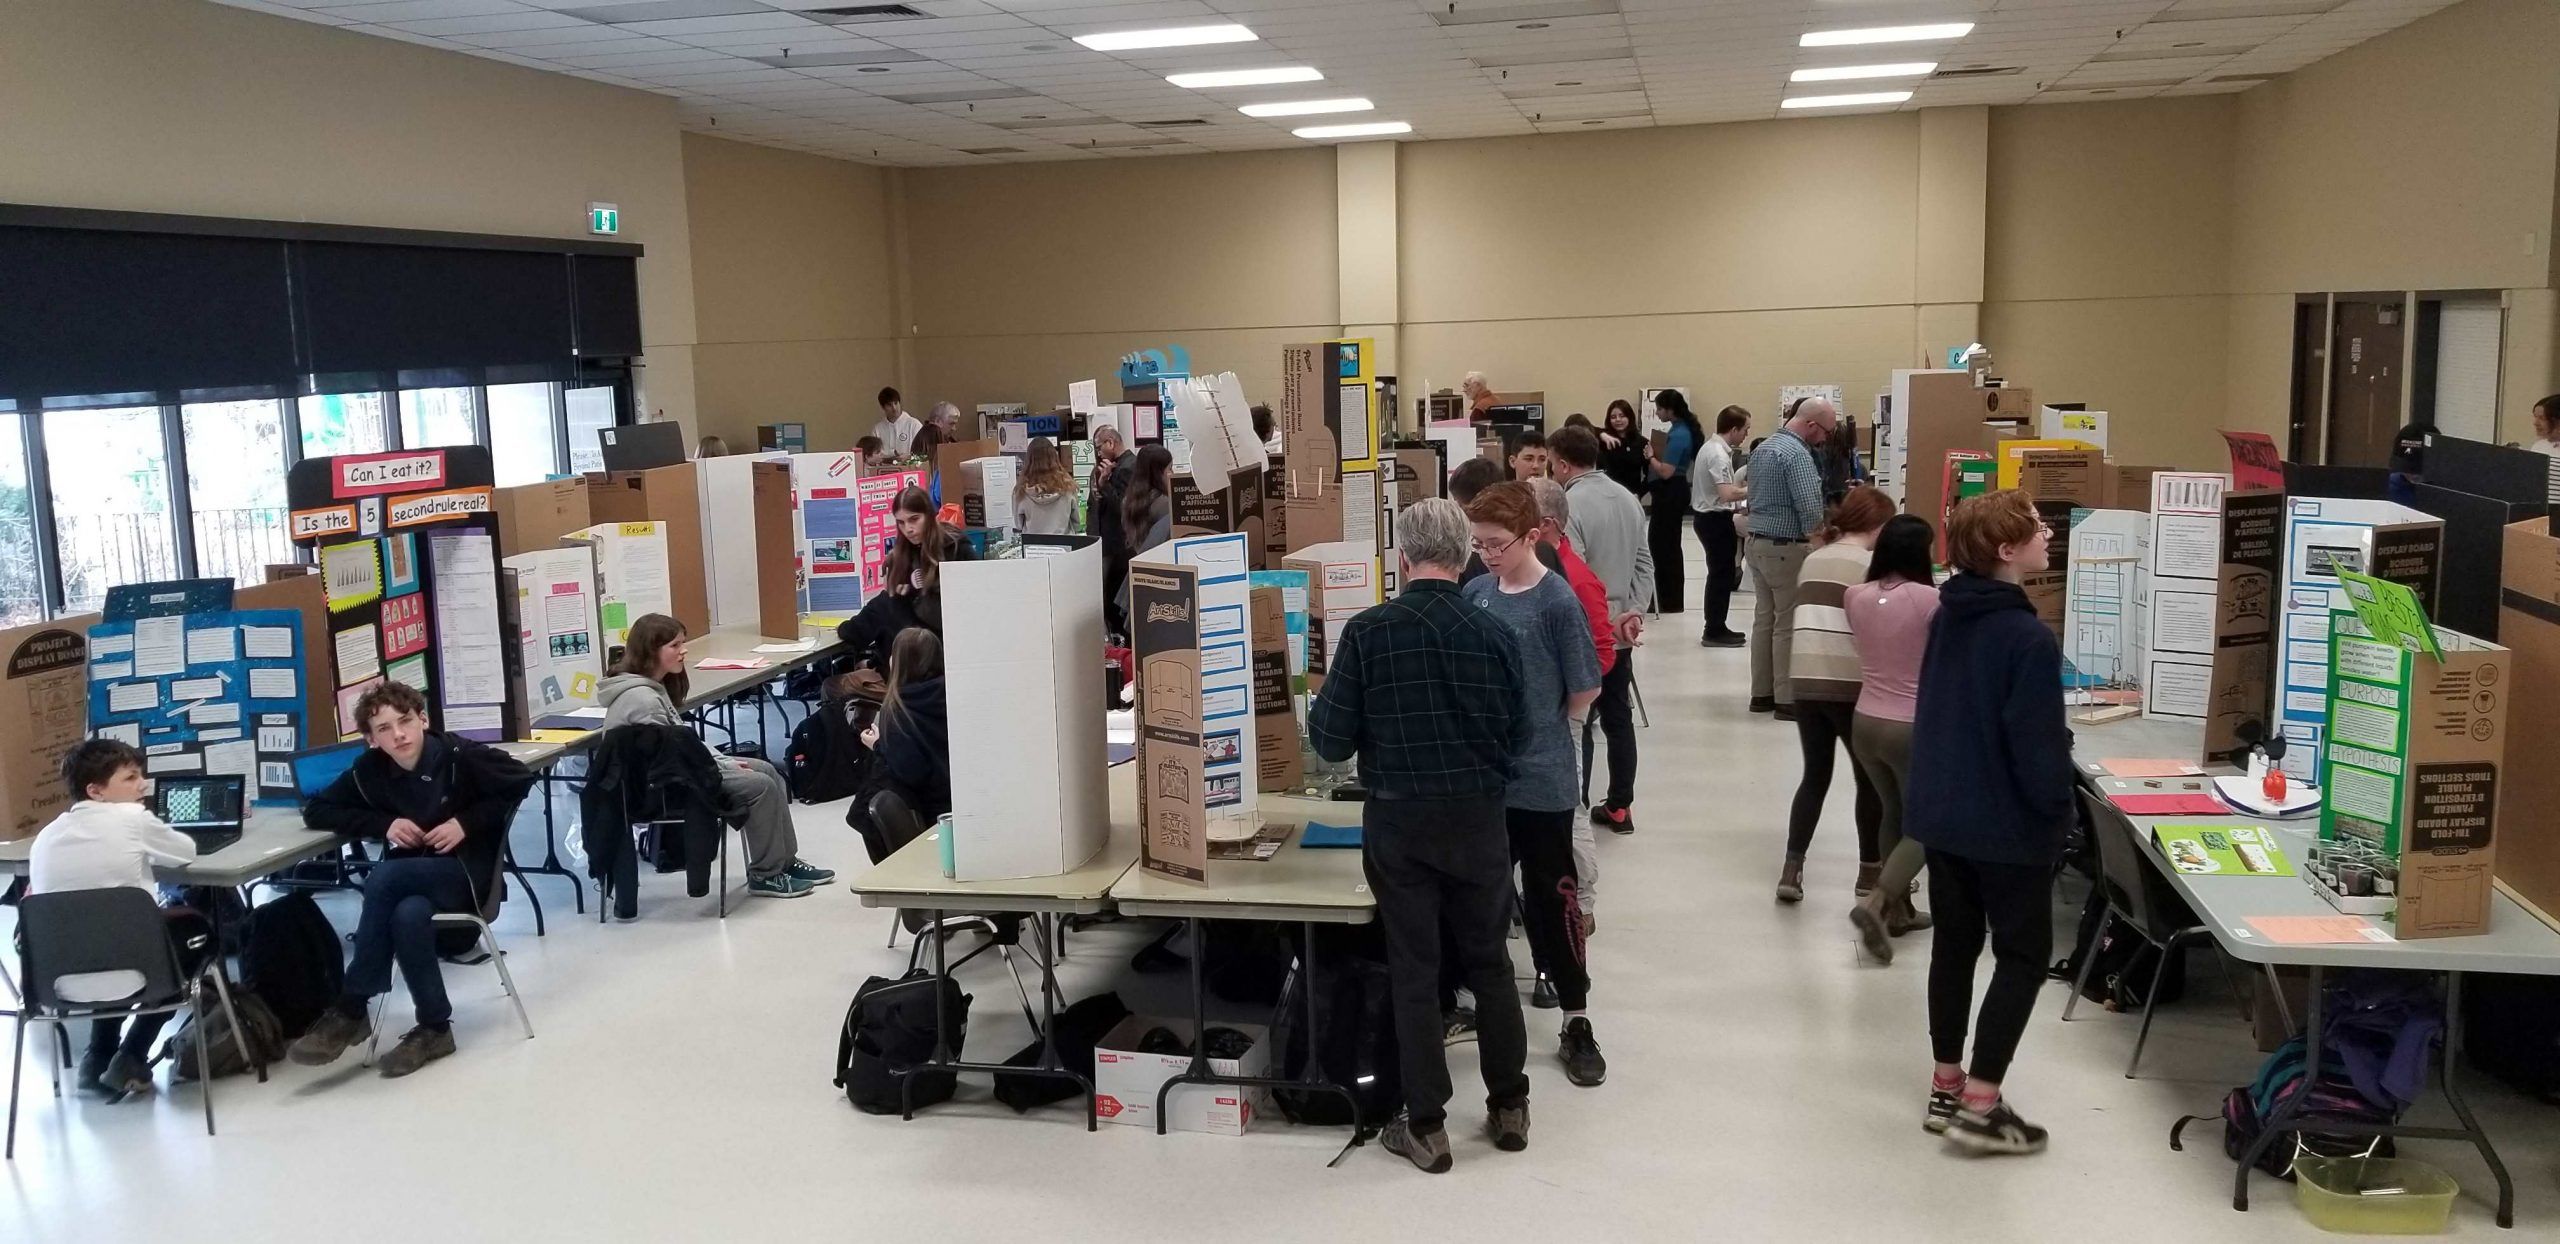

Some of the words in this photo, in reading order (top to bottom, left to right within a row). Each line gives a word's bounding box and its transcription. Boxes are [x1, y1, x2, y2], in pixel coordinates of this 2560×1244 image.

[351, 468, 374, 483] Can
[379, 465, 388, 480] I
[391, 464, 412, 479] eat
[415, 460, 432, 476] it?
[366, 508, 376, 524] 5
[2228, 508, 2257, 518] DISPLAY
[2258, 506, 2279, 515] BOARD
[302, 516, 318, 532] Is
[325, 513, 349, 529] the
[2233, 550, 2242, 559] DE
[2378, 545, 2408, 555] DISPLAY
[2408, 543, 2434, 553] BOARD
[2335, 616, 2361, 634] QUE
[31, 636, 72, 653] PROJECT
[17, 651, 58, 669] DISPLAY
[2340, 681, 2395, 706] PURPOSE
[2331, 745, 2400, 774] HYPOTHESIS
[2420, 773, 2464, 783] SECTIONS
[2466, 772, 2491, 781] TROIS
[2438, 783, 2472, 793] PLIABLE
[2424, 793, 2485, 804] D'EXPOSITION
[2433, 804, 2474, 814] PANNEAU
[2417, 818, 2448, 828] BOARD
[2449, 816, 2485, 827] DISPLAY
[2431, 828, 2470, 839] TRI-FOLD
